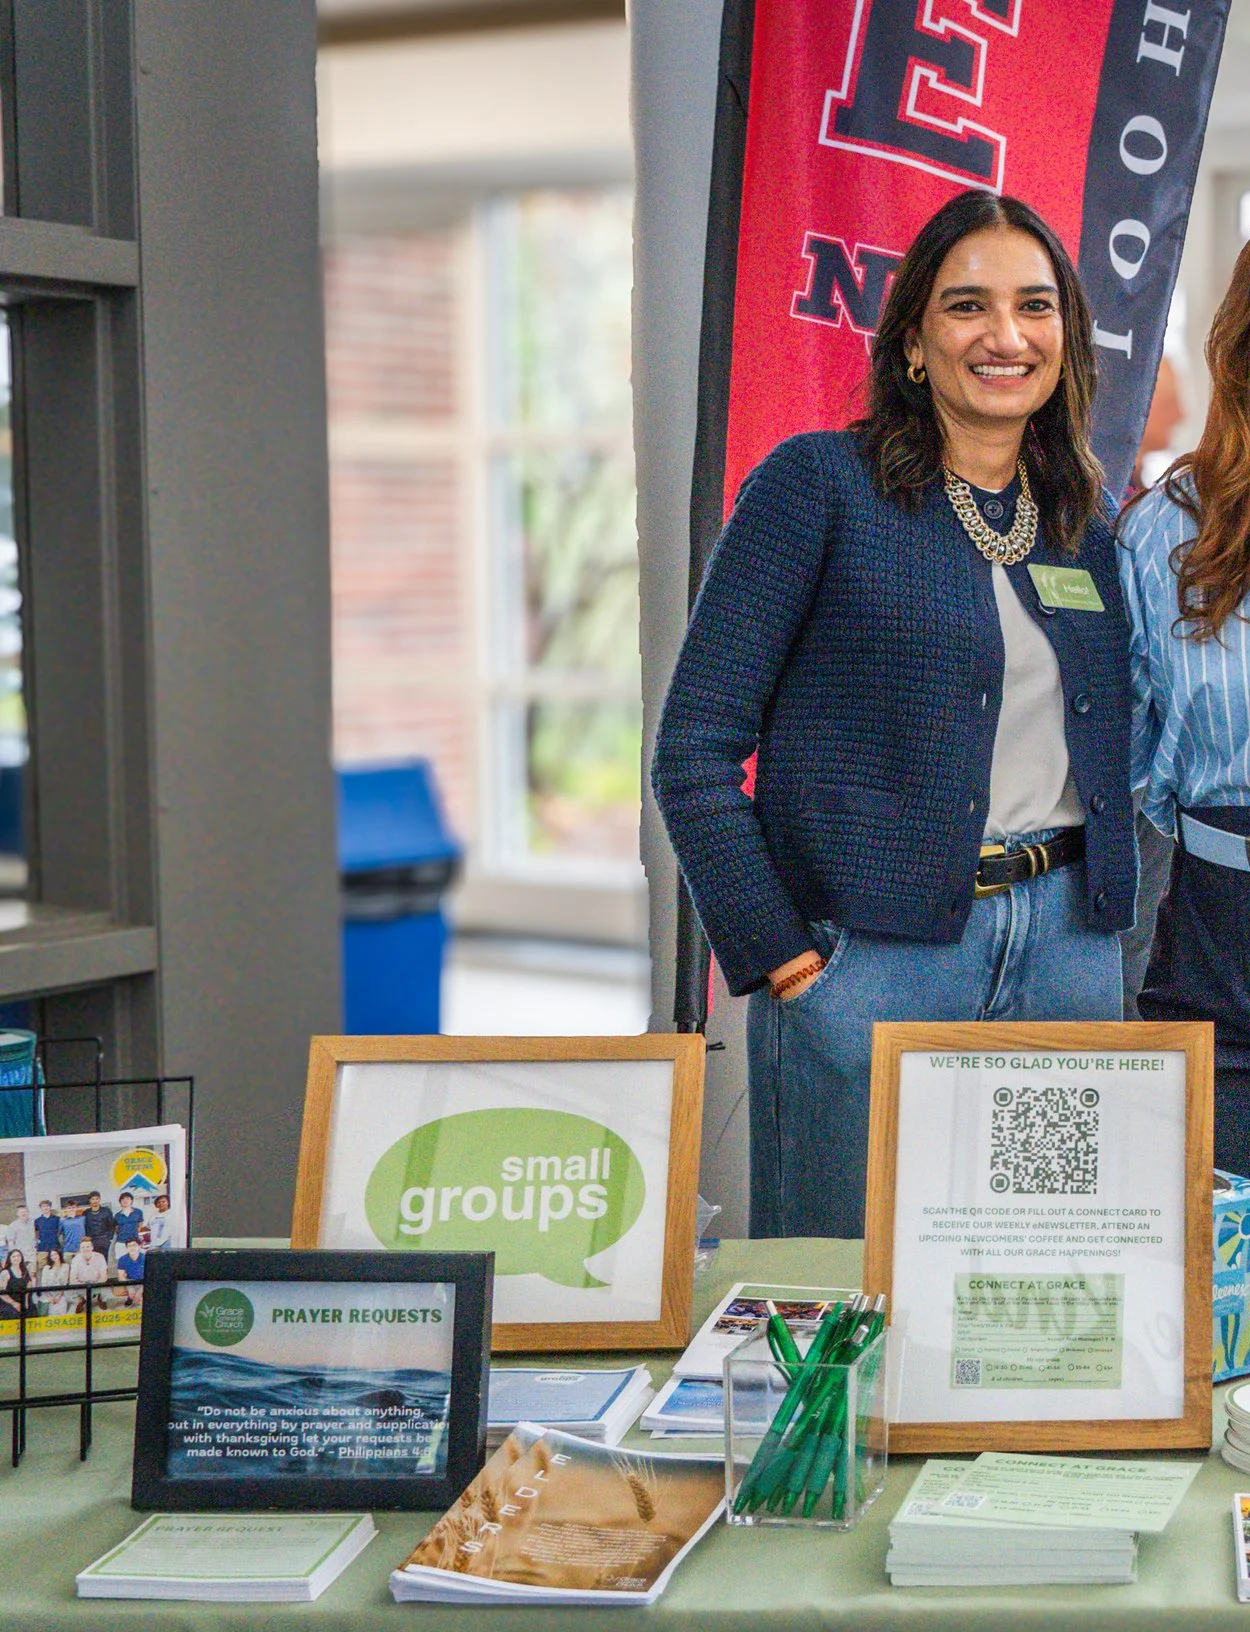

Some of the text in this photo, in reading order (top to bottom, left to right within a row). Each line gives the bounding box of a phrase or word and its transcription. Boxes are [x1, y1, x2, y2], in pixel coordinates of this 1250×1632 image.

[929, 1056, 1165, 1071] WE'RE SO GLAD YOU'RE HERE!
[501, 1148, 612, 1182] small
[399, 1184, 609, 1235] groups
[922, 1206, 1161, 1217] SCAN THE QR CODE OR FILL OUT A CONNECT CARD TO
[932, 1221, 971, 1230] RECEIVE
[972, 1221, 993, 1230] OUR
[994, 1221, 1031, 1230] WEEKLY
[1101, 1222, 1136, 1231] ATTEND
[1137, 1222, 1151, 1231] AN
[963, 1235, 1027, 1244] NEWCOMERS'
[1028, 1235, 1064, 1244] COFFEE
[1065, 1235, 1086, 1244] AND
[1087, 1235, 1105, 1244] GET
[1106, 1235, 1163, 1245] CONNECTED
[960, 1248, 1121, 1258] WITH ALL OUR GRACE HAPPENINGS!
[968, 1280, 1086, 1291] CONNECT AT GRACE
[215, 1306, 245, 1316] Grace
[271, 1308, 443, 1324] PRAYER REQUESTS
[45, 1316, 83, 1328] GRADE
[197, 1405, 425, 1420] "Do not be anxious about anything,
[192, 1420, 204, 1431] in
[208, 1420, 277, 1434] everything
[281, 1420, 297, 1433] by
[301, 1422, 344, 1433] prayer
[348, 1420, 371, 1431] and
[183, 1433, 432, 1447] with thanksgiving let your requests be
[187, 1447, 222, 1458] made
[226, 1446, 269, 1458] known
[272, 1447, 287, 1458] to
[338, 1447, 409, 1460] Philippians
[995, 1458, 1070, 1468] CONNECT
[1095, 1465, 1148, 1473] GRACE
